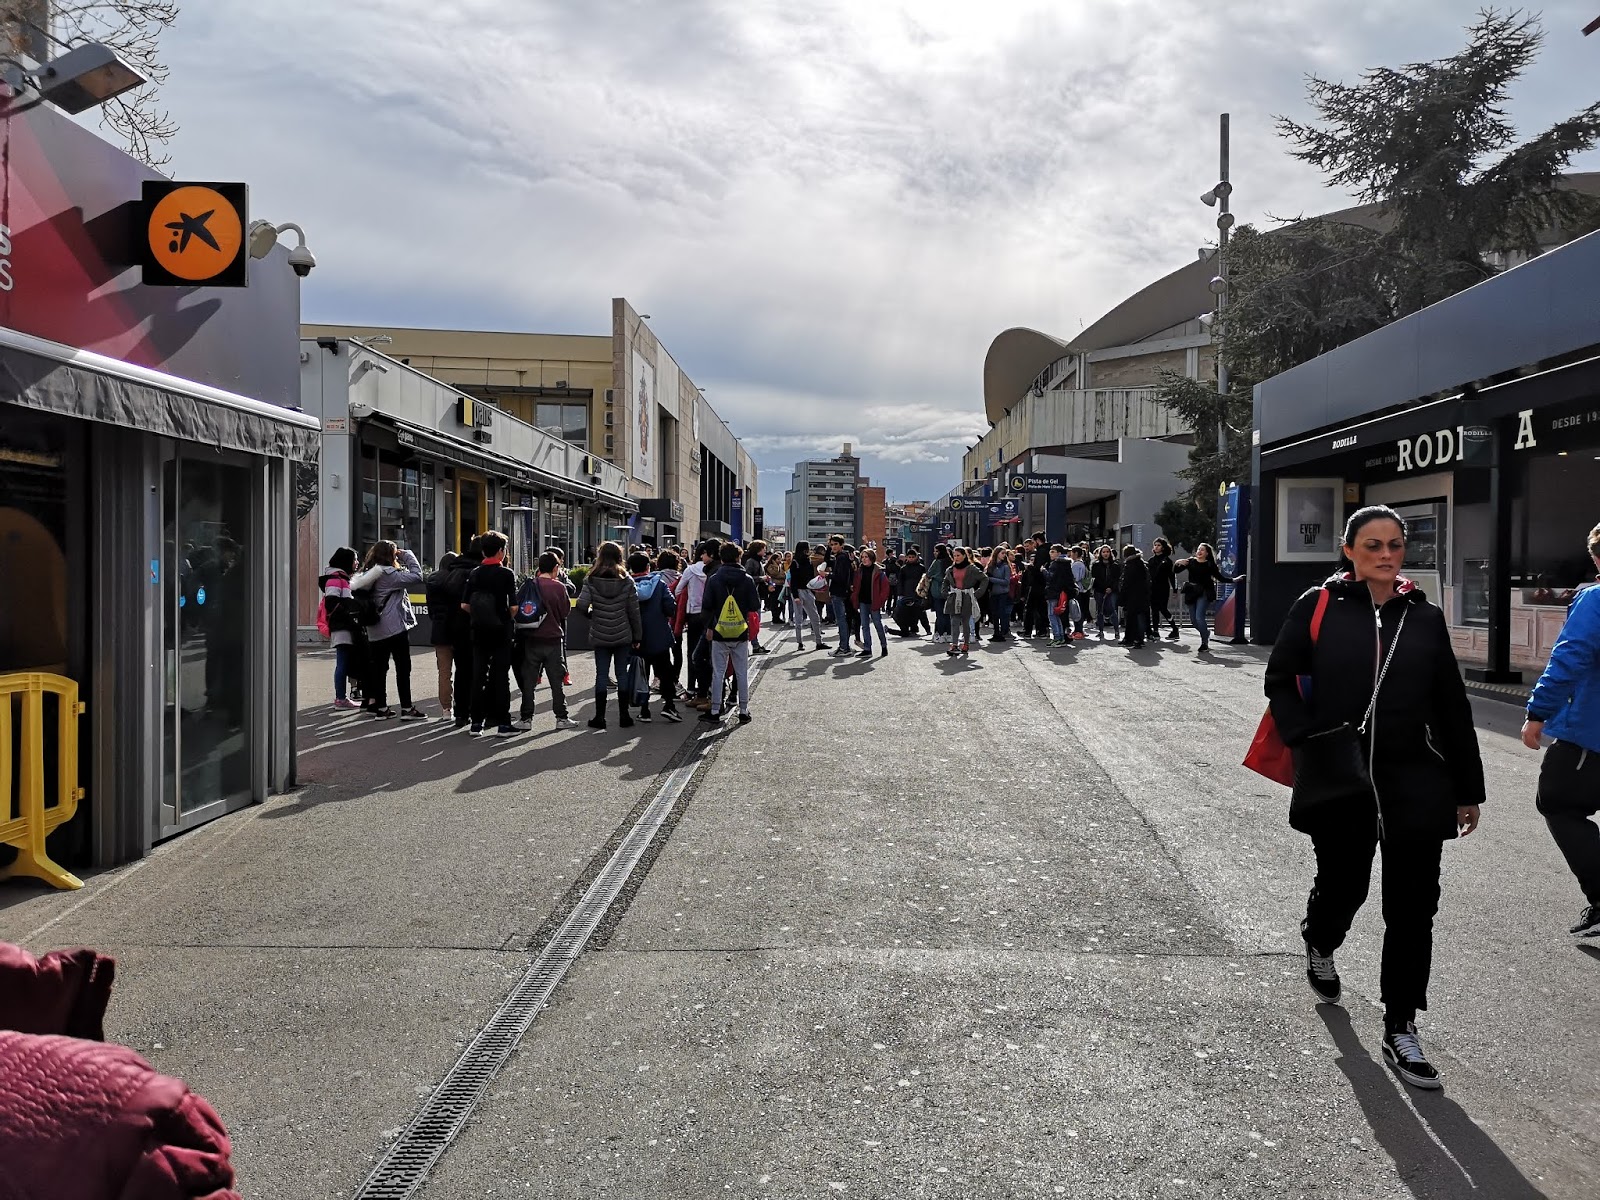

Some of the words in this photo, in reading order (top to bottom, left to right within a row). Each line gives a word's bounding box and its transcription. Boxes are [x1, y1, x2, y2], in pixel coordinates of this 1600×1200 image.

[473, 402, 492, 428] pans
[1552, 414, 1581, 429] DESDE
[1332, 435, 1357, 449] RODILLA
[1300, 523, 1321, 535] EVERY
[1304, 534, 1317, 545] DAY
[410, 605, 429, 615] ans
